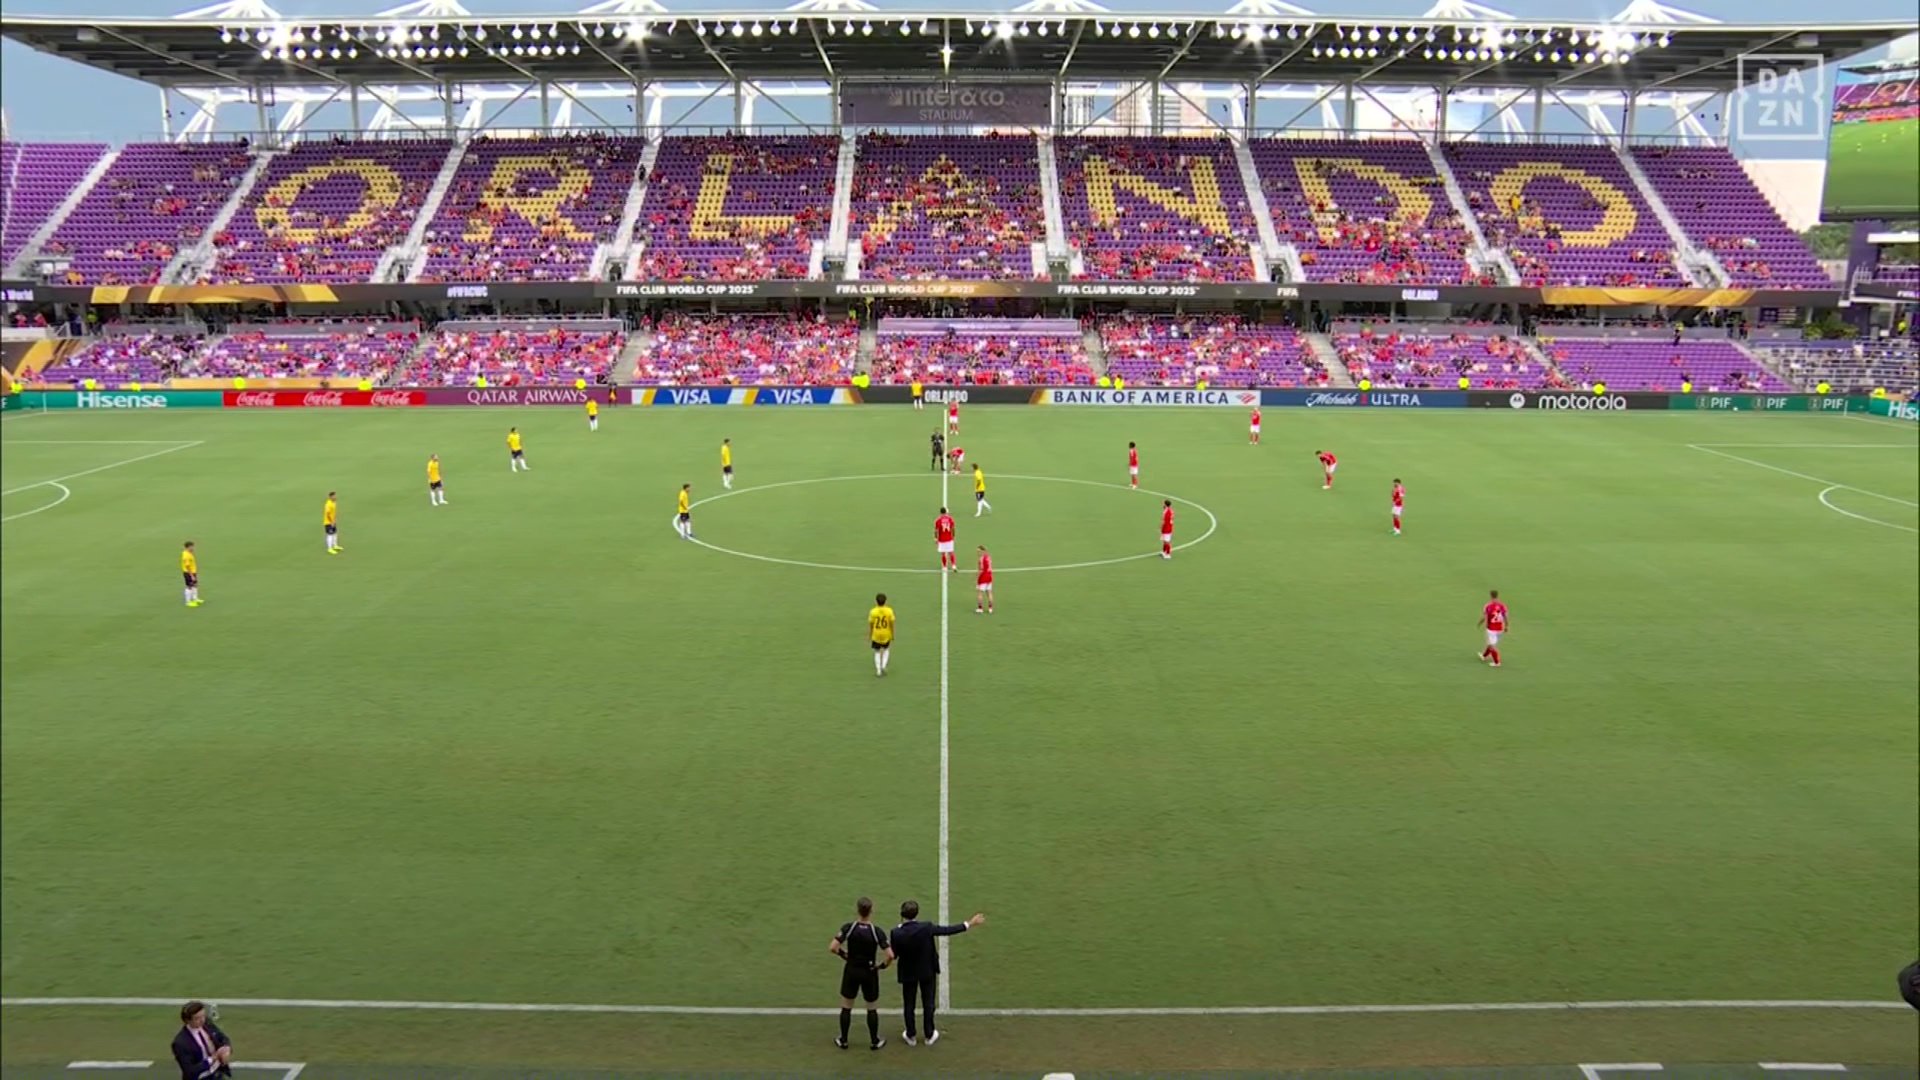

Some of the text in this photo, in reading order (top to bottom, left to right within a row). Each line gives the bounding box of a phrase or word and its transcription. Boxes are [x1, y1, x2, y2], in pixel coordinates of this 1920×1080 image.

[919, 108, 974, 121] STADIUM
[616, 285, 638, 295] FIFA
[640, 285, 666, 295] CLUB
[667, 285, 705, 295] WORLD
[706, 285, 727, 295] CUP
[836, 285, 858, 295] FIFA
[860, 285, 886, 295] CLUB
[887, 285, 925, 295] WORLD
[1057, 285, 1080, 295] FIFA
[1081, 285, 1108, 295] CLUB
[1108, 285, 1147, 295] WORLD
[1148, 285, 1169, 296] CUP
[1277, 287, 1299, 298] FIFA
[77, 391, 168, 408] Hisense
[467, 390, 588, 405] QATAR AIRWAYS
[669, 389, 711, 404] VISA
[771, 389, 814, 404] VISA
[1054, 391, 1229, 405] BANK OF AMERICA
[1371, 393, 1421, 406] ULTRA
[1538, 393, 1626, 410] motorola
[1711, 398, 1732, 408] PIF
[1767, 398, 1788, 408] PIF
[1823, 398, 1844, 409] PIF
[875, 616, 888, 629] 26
